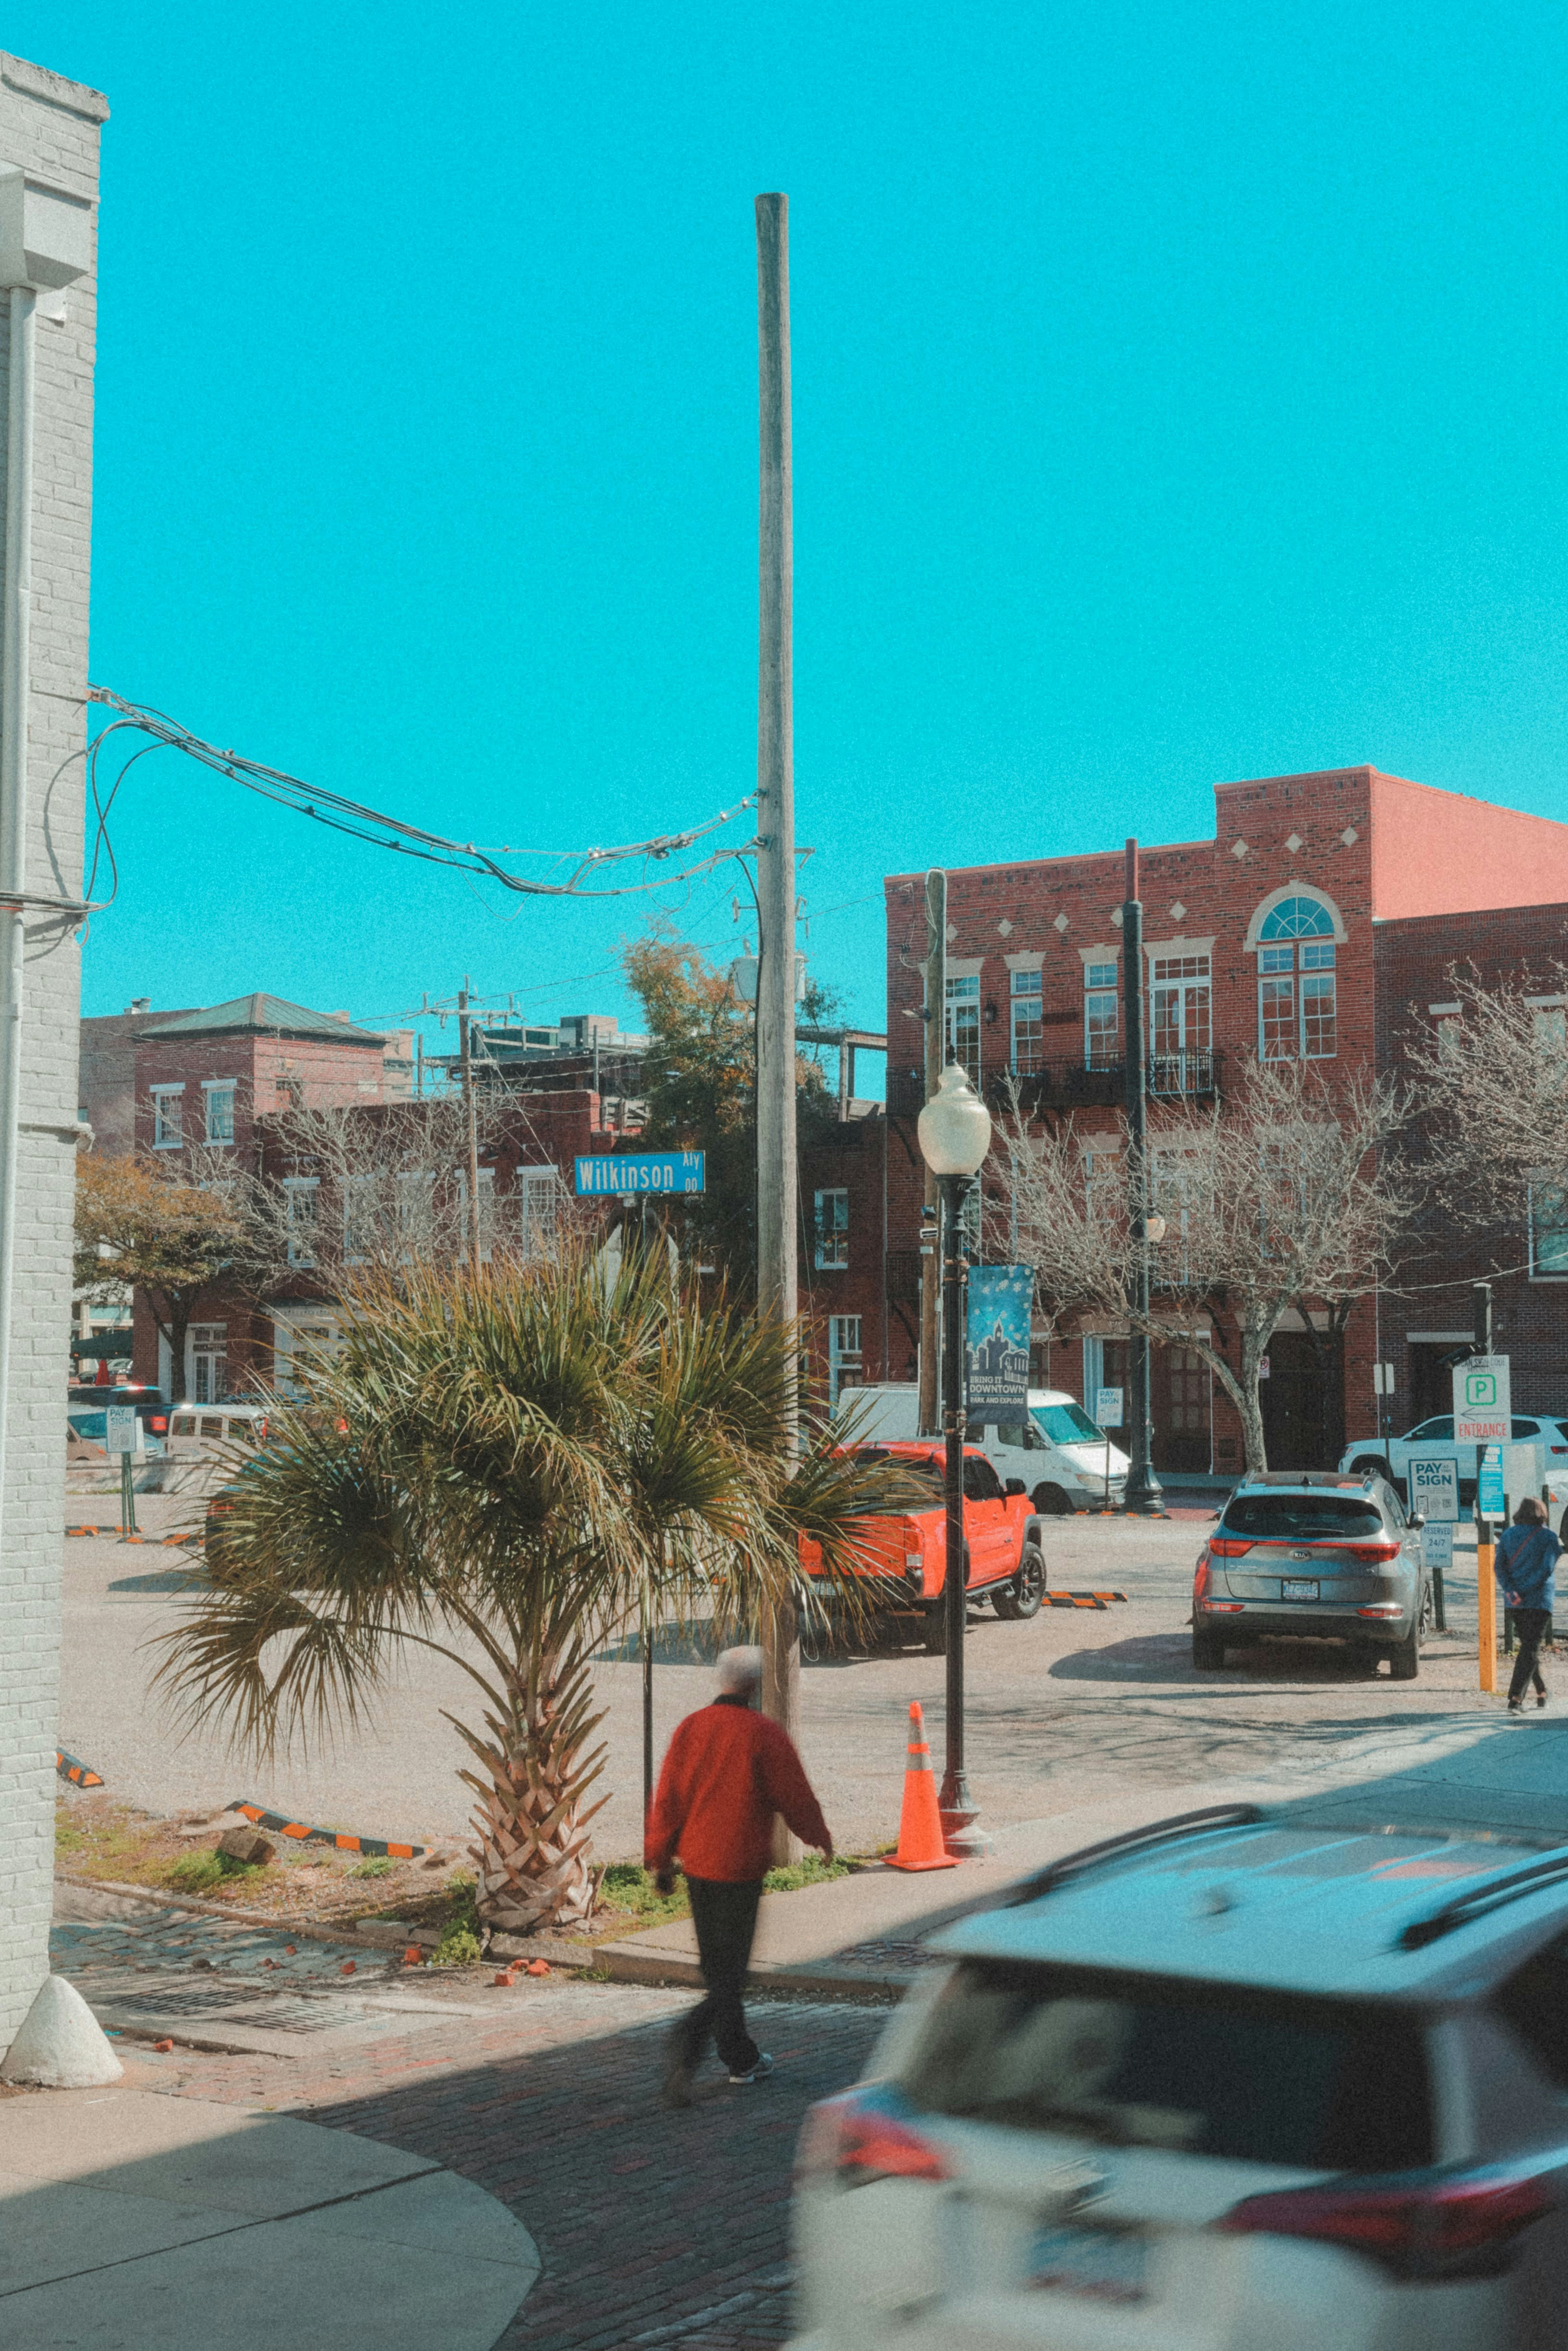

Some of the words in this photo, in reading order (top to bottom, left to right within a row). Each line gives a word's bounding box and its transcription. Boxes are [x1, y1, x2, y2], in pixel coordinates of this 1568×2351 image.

[579, 1160, 673, 1191] Wilkinson
[683, 1152, 700, 1170] Aly
[685, 1178, 698, 1193] 00
[970, 1384, 1025, 1394] DOWNTOWN
[111, 1417, 131, 1425] SIGN
[1459, 1423, 1507, 1437] ENTRANCE
[1416, 1462, 1442, 1474] PAY
[1417, 1474, 1452, 1486] SIGN
[1423, 1527, 1450, 1535] RESERVED
[1429, 1539, 1446, 1547] 24/7
